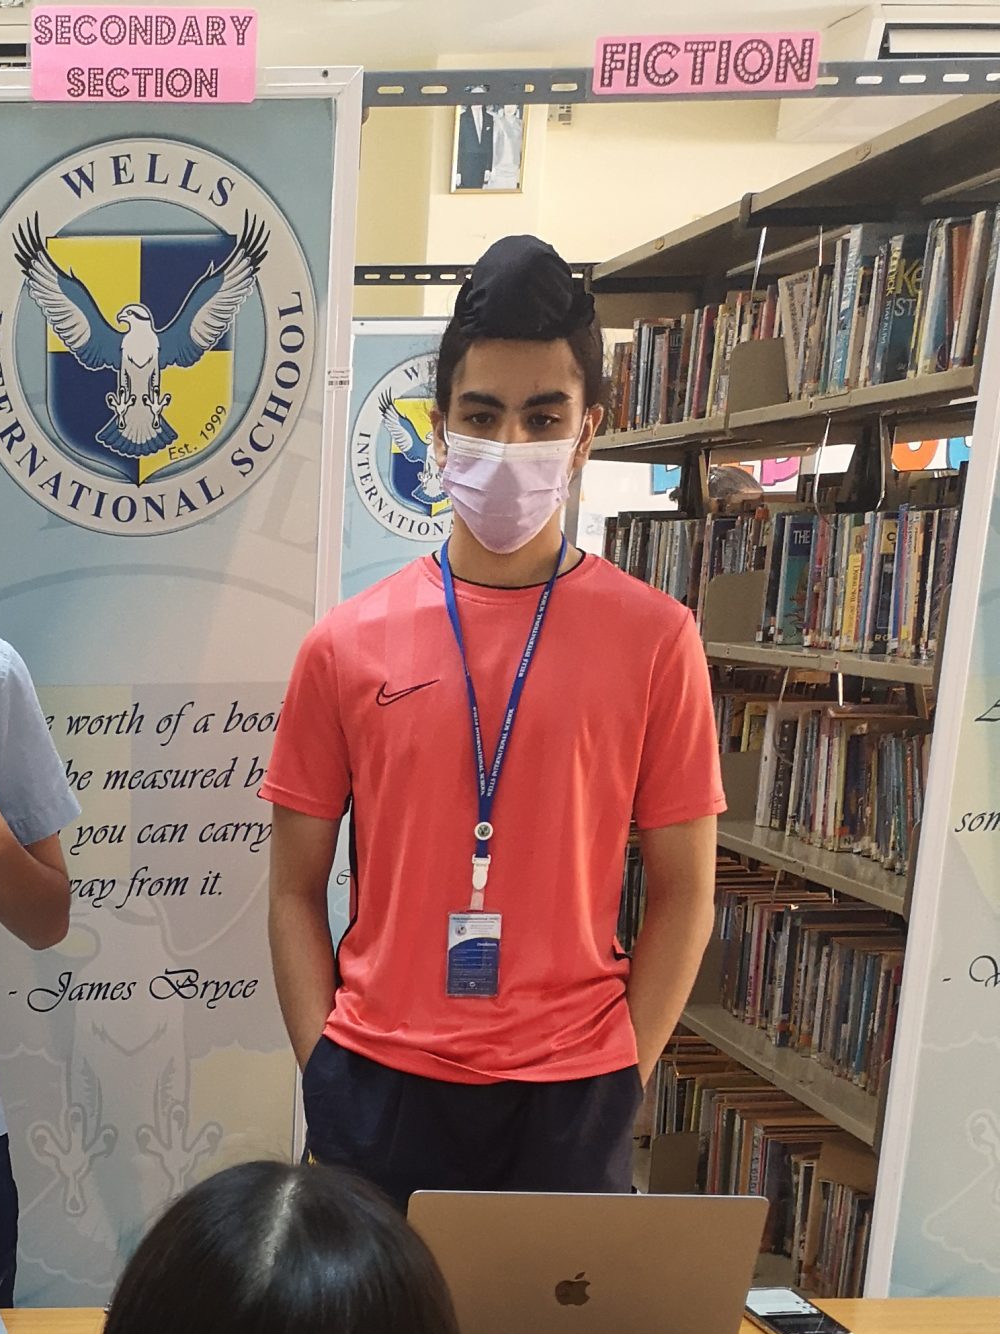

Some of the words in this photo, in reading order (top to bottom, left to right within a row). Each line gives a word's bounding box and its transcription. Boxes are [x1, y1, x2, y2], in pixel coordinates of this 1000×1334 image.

[34, 14, 254, 46] SECONDARY
[66, 67, 219, 98] SECTION
[600, 38, 815, 88] FICTION
[60, 152, 236, 208] WELLS
[230, 290, 306, 478] SCHOOL
[168, 444, 198, 461] Est.
[200, 404, 228, 441] 1999
[66, 702, 145, 736] worth
[156, 701, 195, 747] of
[192, 712, 215, 735] a
[103, 756, 239, 791] measured
[70, 824, 127, 856] you
[136, 823, 189, 844] can
[114, 865, 189, 909] from
[199, 869, 223, 897] it.
[26, 970, 137, 1013] James
[149, 968, 259, 1010] Bryce
